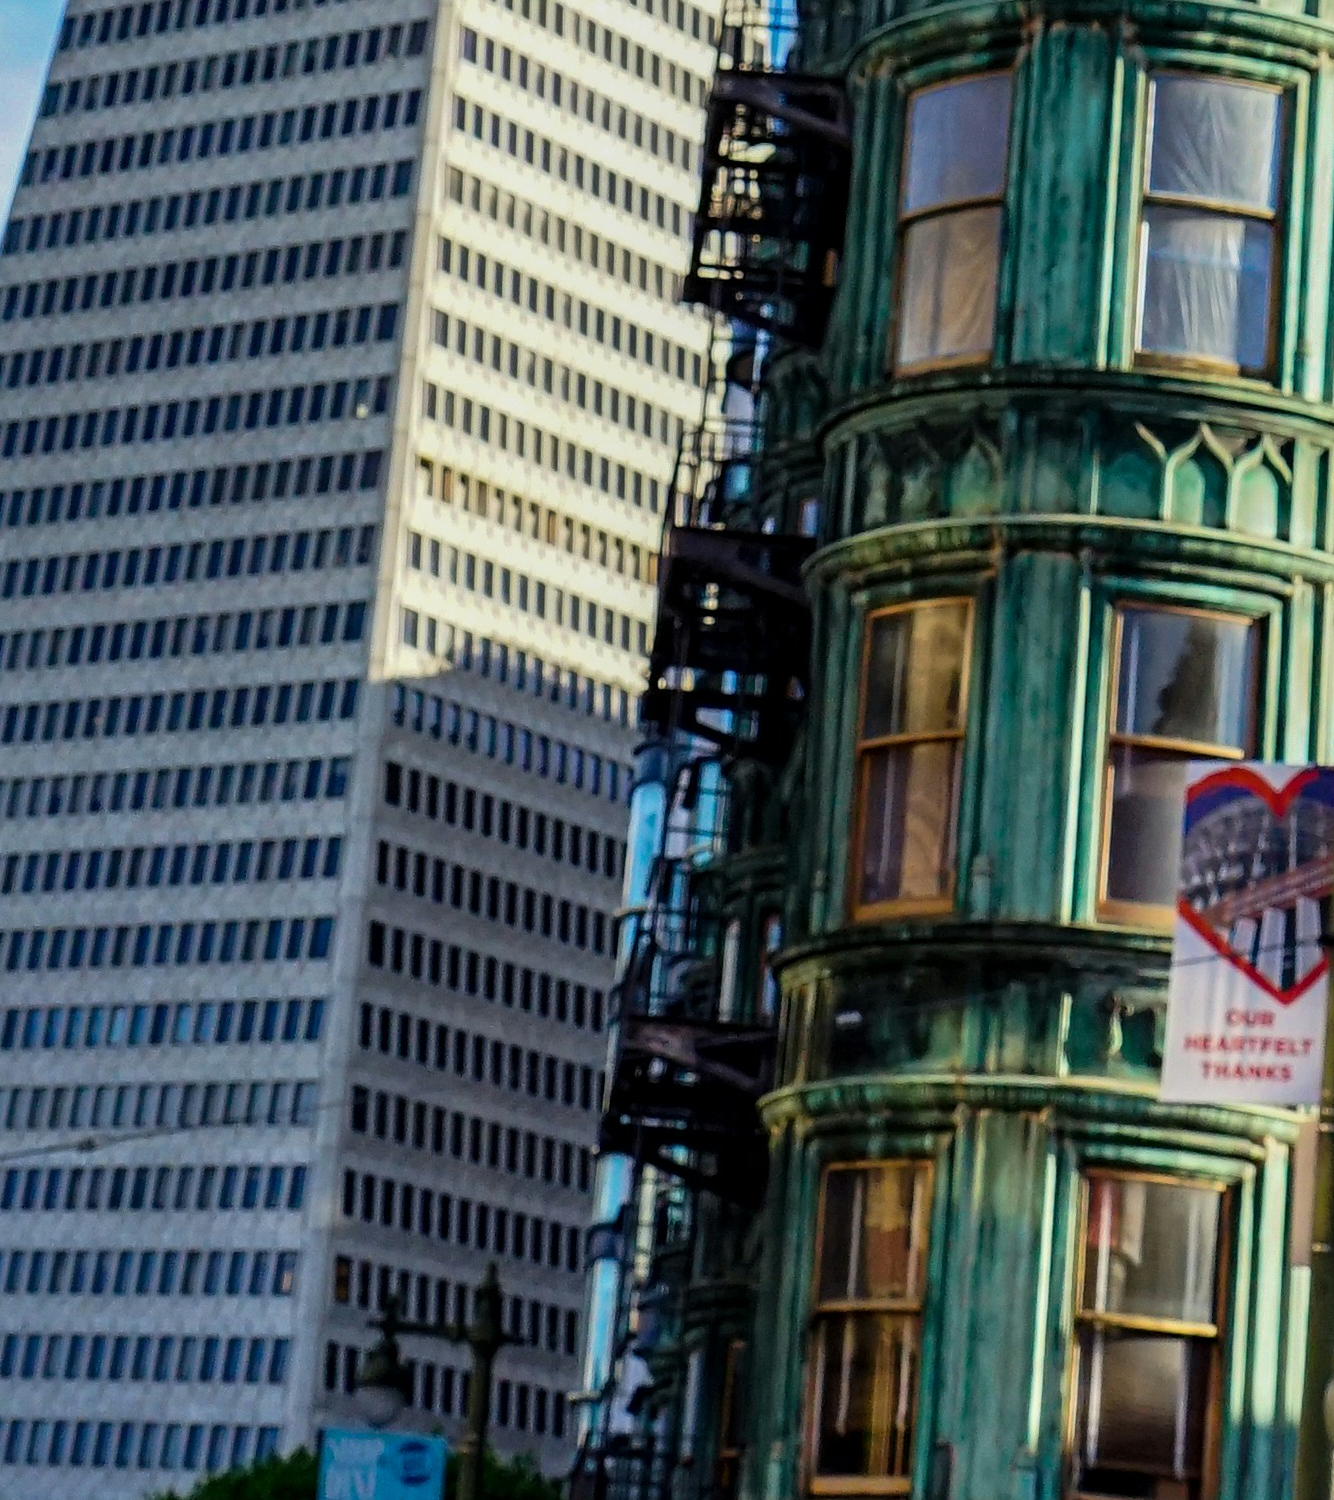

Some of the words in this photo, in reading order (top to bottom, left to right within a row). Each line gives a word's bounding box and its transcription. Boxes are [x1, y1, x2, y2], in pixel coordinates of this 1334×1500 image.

[1226, 1008, 1275, 1027] OUR
[1184, 1033, 1313, 1056] HEARTFELT
[1202, 1060, 1294, 1082] THANKS
